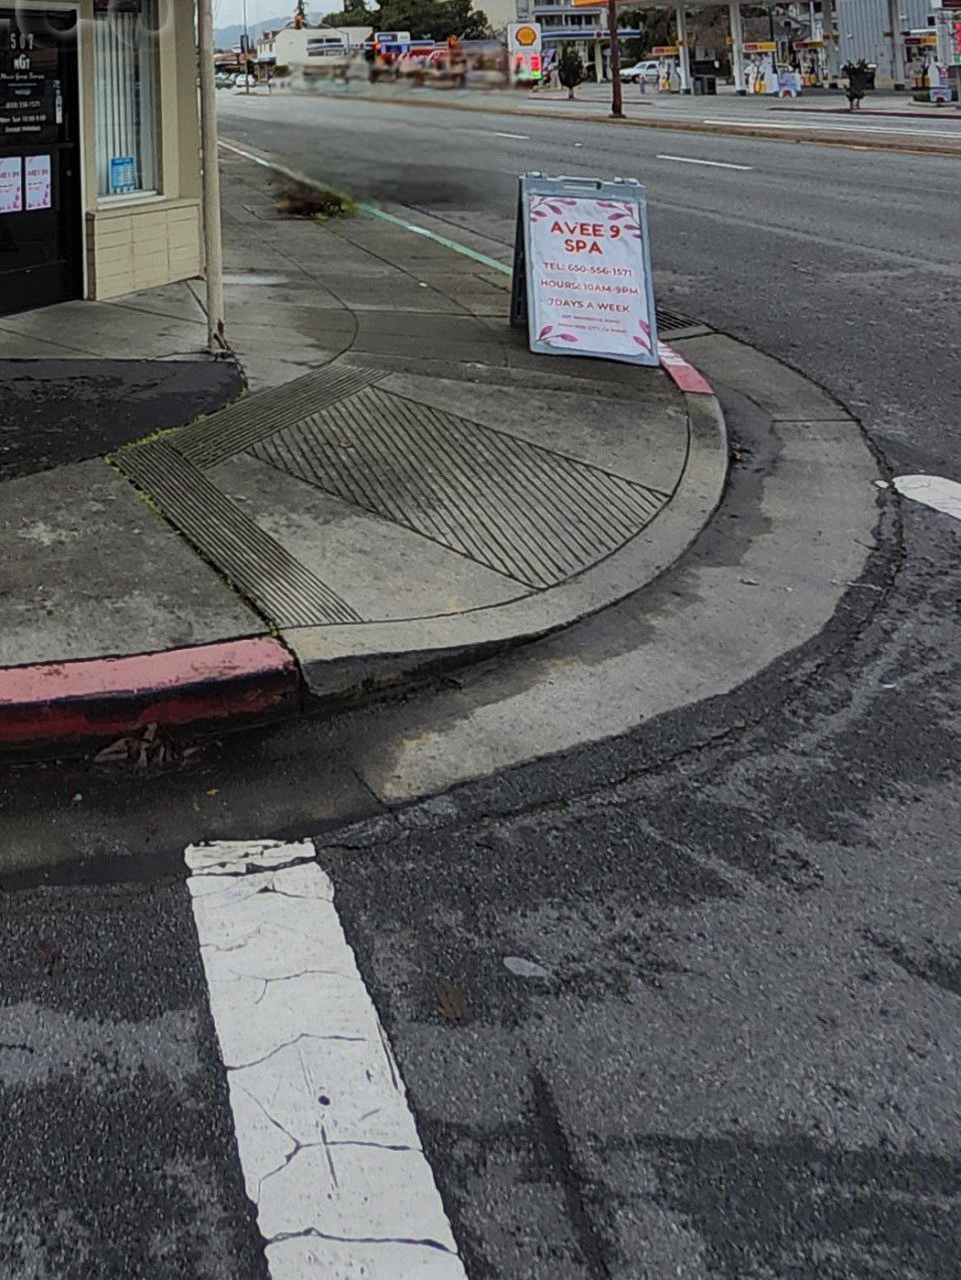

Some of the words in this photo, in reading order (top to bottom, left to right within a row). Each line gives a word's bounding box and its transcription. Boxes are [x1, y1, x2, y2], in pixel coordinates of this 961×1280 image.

[550, 220, 605, 238] AVEE
[609, 224, 621, 239] 9
[564, 238, 603, 255] SPA
[586, 301, 594, 310] A
[596, 302, 631, 313] WEEK
